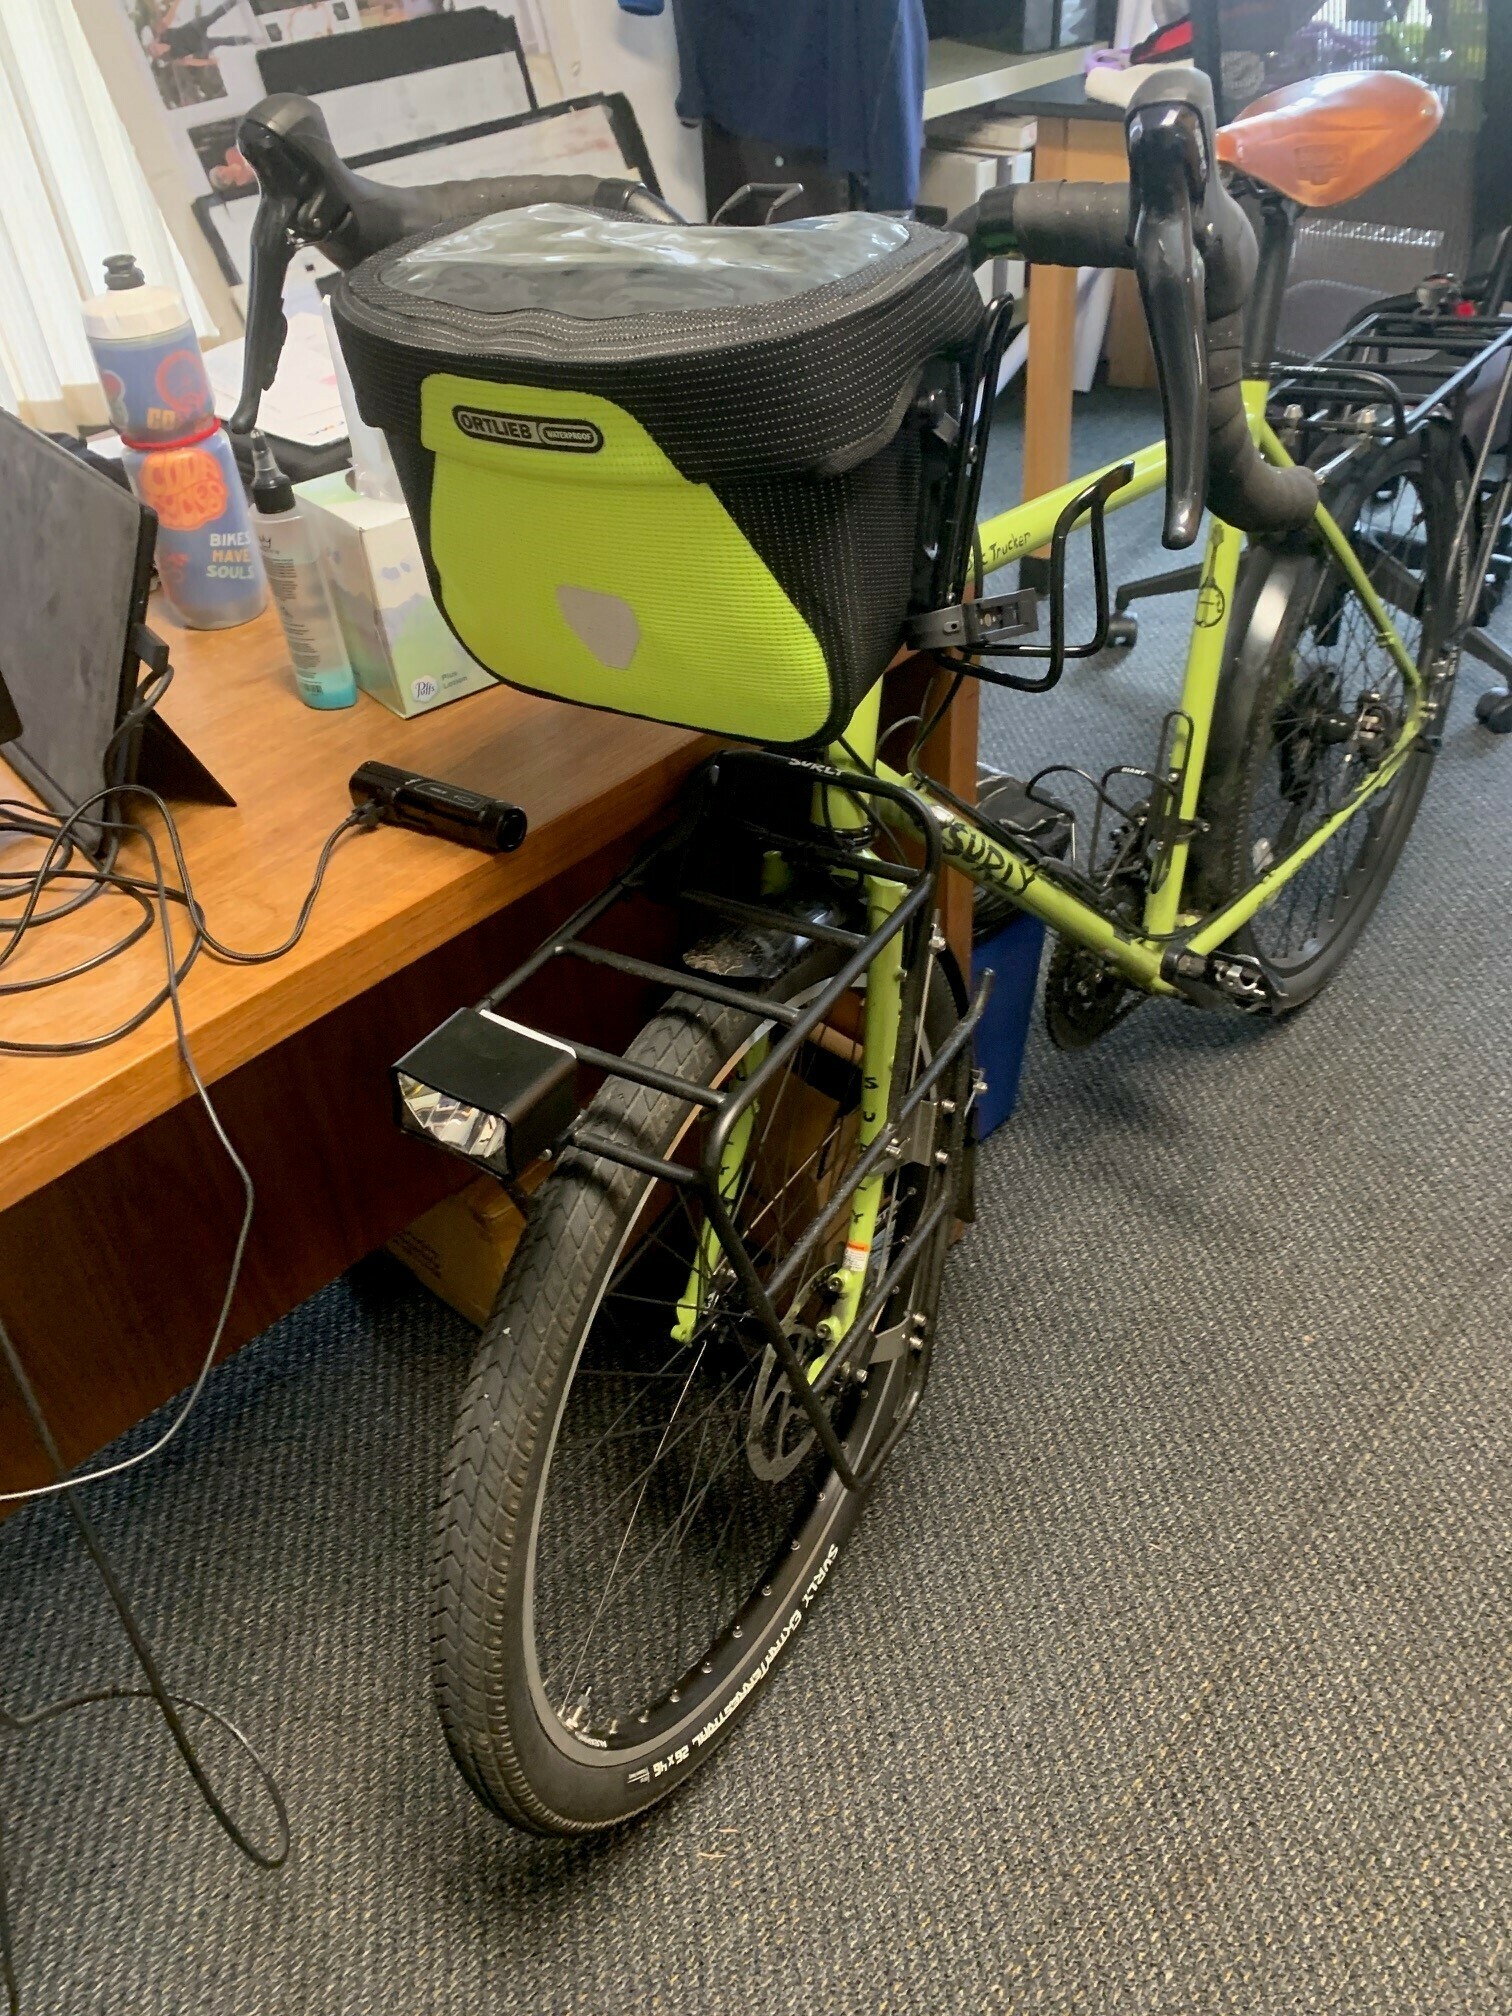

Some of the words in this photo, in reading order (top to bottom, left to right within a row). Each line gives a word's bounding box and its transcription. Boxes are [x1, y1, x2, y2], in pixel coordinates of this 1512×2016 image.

[460, 414, 532, 440] ORTLIEB
[545, 430, 591, 441] WATERPROOF
[209, 532, 250, 548] BIKES
[989, 531, 1031, 561] Trucker
[212, 549, 250, 563] HAVE
[206, 565, 254, 579] SOULS
[415, 682, 435, 697] Puffs
[788, 758, 841, 776] SURLY
[942, 822, 1036, 896] SURLY
[802, 1543, 839, 1608] SURLY
[674, 1744, 690, 1765] 26
[653, 1760, 668, 1778] 46
